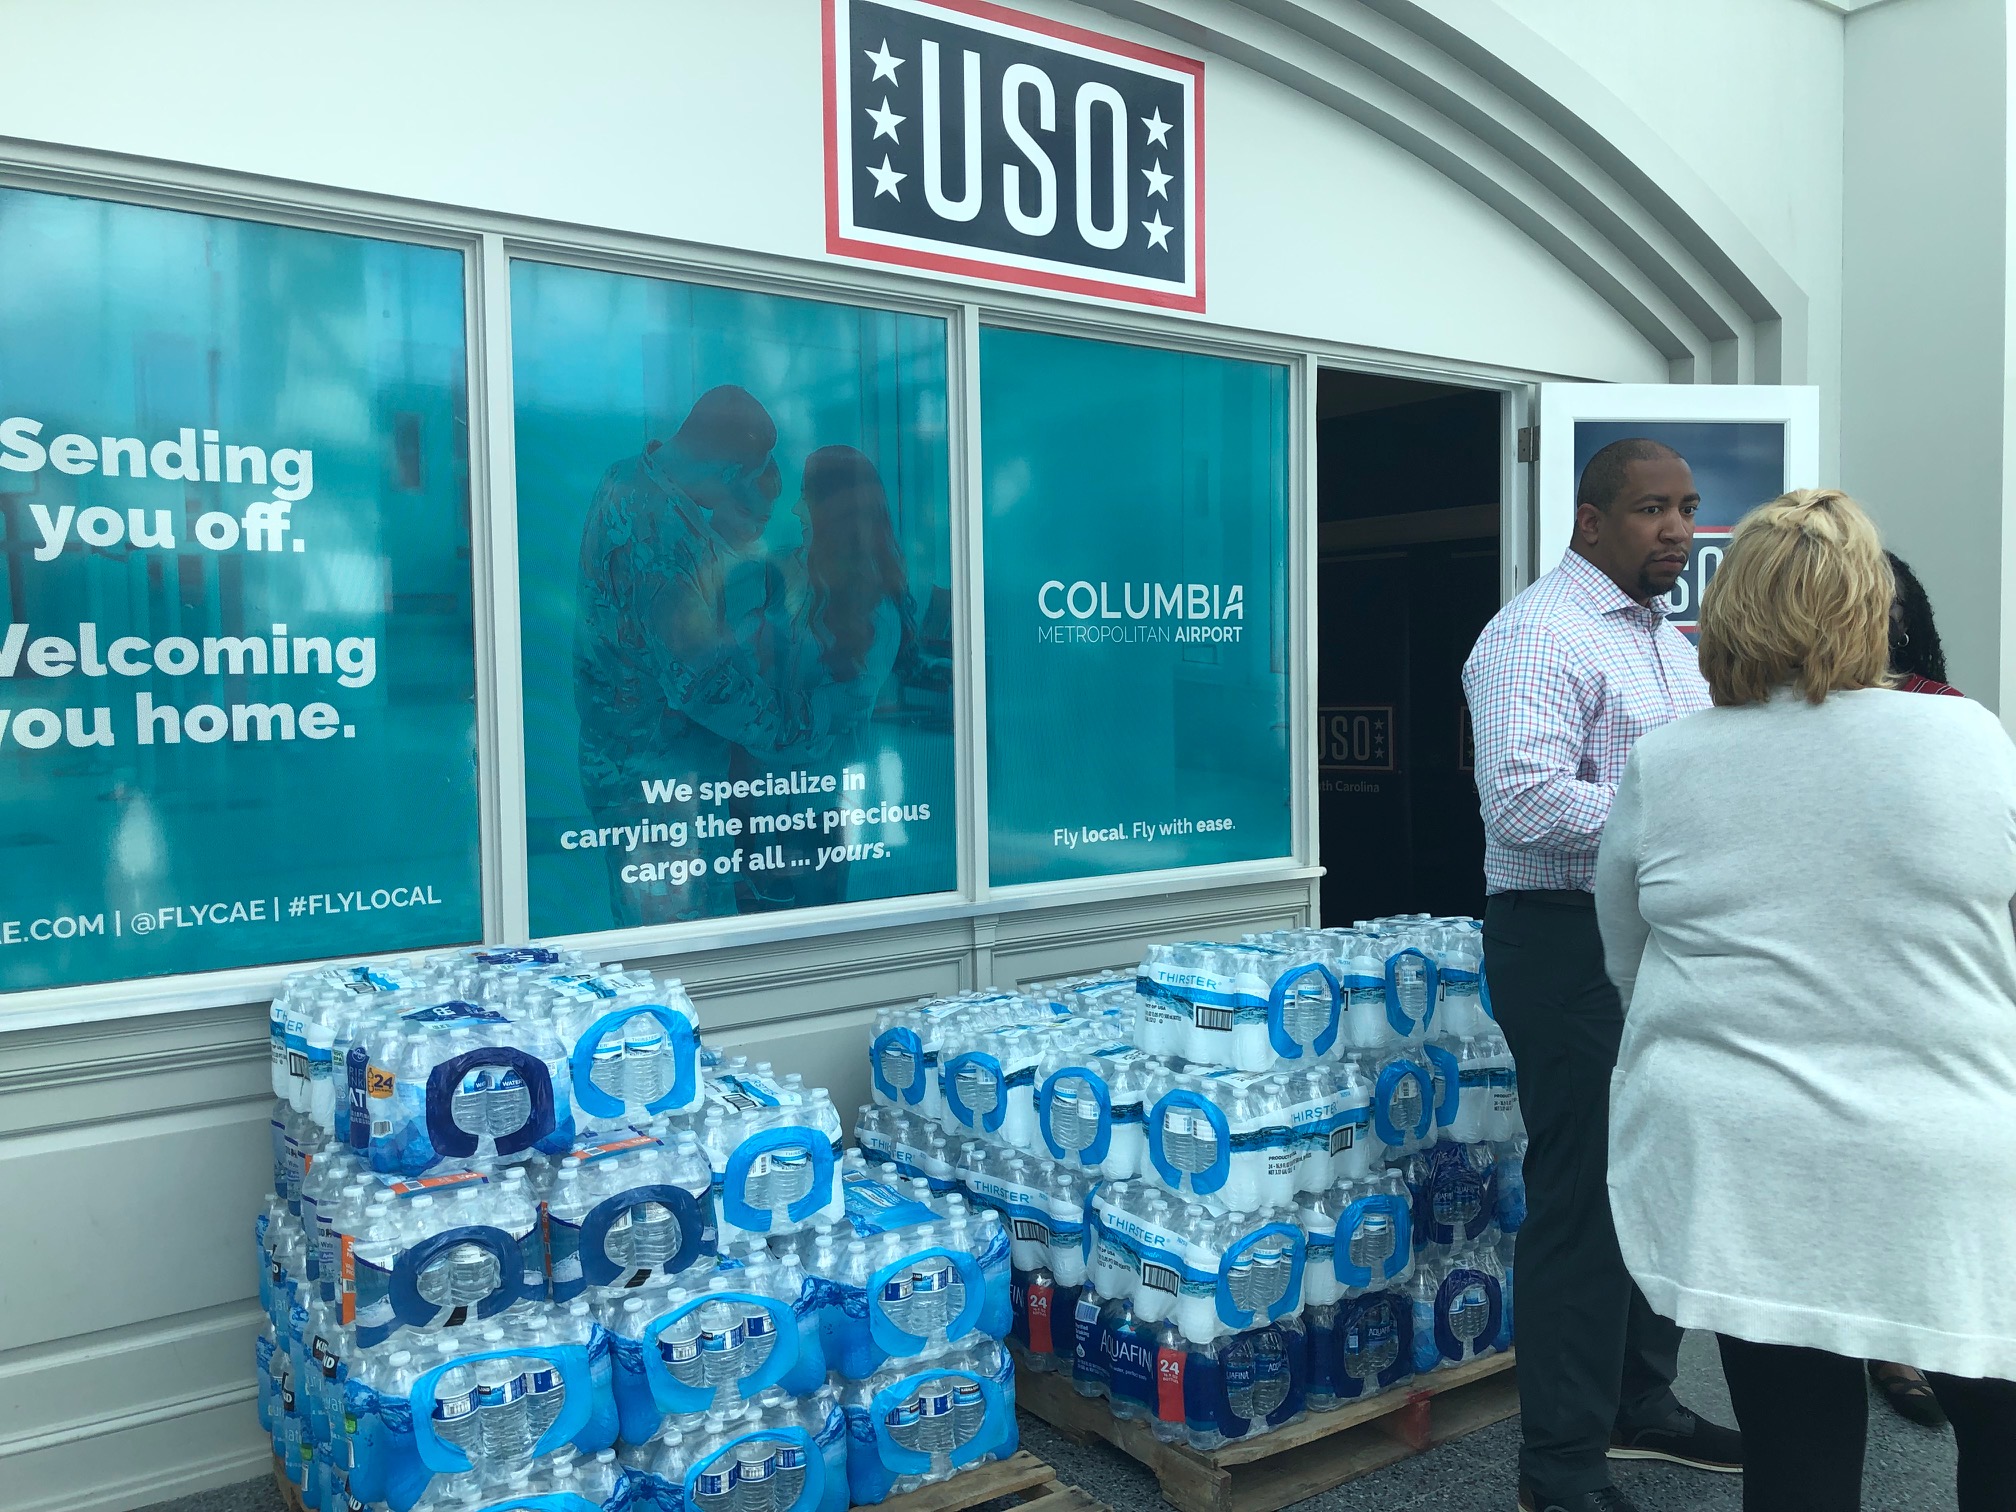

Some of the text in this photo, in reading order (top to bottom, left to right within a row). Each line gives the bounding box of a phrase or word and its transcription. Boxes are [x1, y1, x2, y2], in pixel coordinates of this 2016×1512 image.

[921, 39, 1128, 250] USO
[0, 416, 314, 500] Sending
[31, 500, 305, 562] you off.
[1038, 580, 1244, 620] COLUMBIA
[1038, 625, 1243, 643] METROPOLITAN AIRPORT
[0, 692, 356, 749] ou home.
[641, 768, 865, 806] We specialize in
[1335, 780, 1380, 793] Carolina
[560, 801, 931, 851] carrying the most precious
[1054, 816, 1236, 849] Fly local. Fly with ease.
[620, 857, 707, 885] cargo
[713, 848, 743, 874] of
[748, 845, 786, 871] all
[815, 843, 892, 871] yours.
[0, 912, 104, 945] E.COM
[130, 899, 266, 935] @FLYCAE
[287, 885, 442, 917] #FLYLOCAL
[1158, 970, 1217, 990] THIRSTER
[374, 1073, 394, 1090] 24
[974, 1180, 1030, 1203] THIRSTER
[1107, 1213, 1166, 1247] THIRSTER
[1030, 1294, 1048, 1309] 24
[1160, 1359, 1180, 1375] 24
